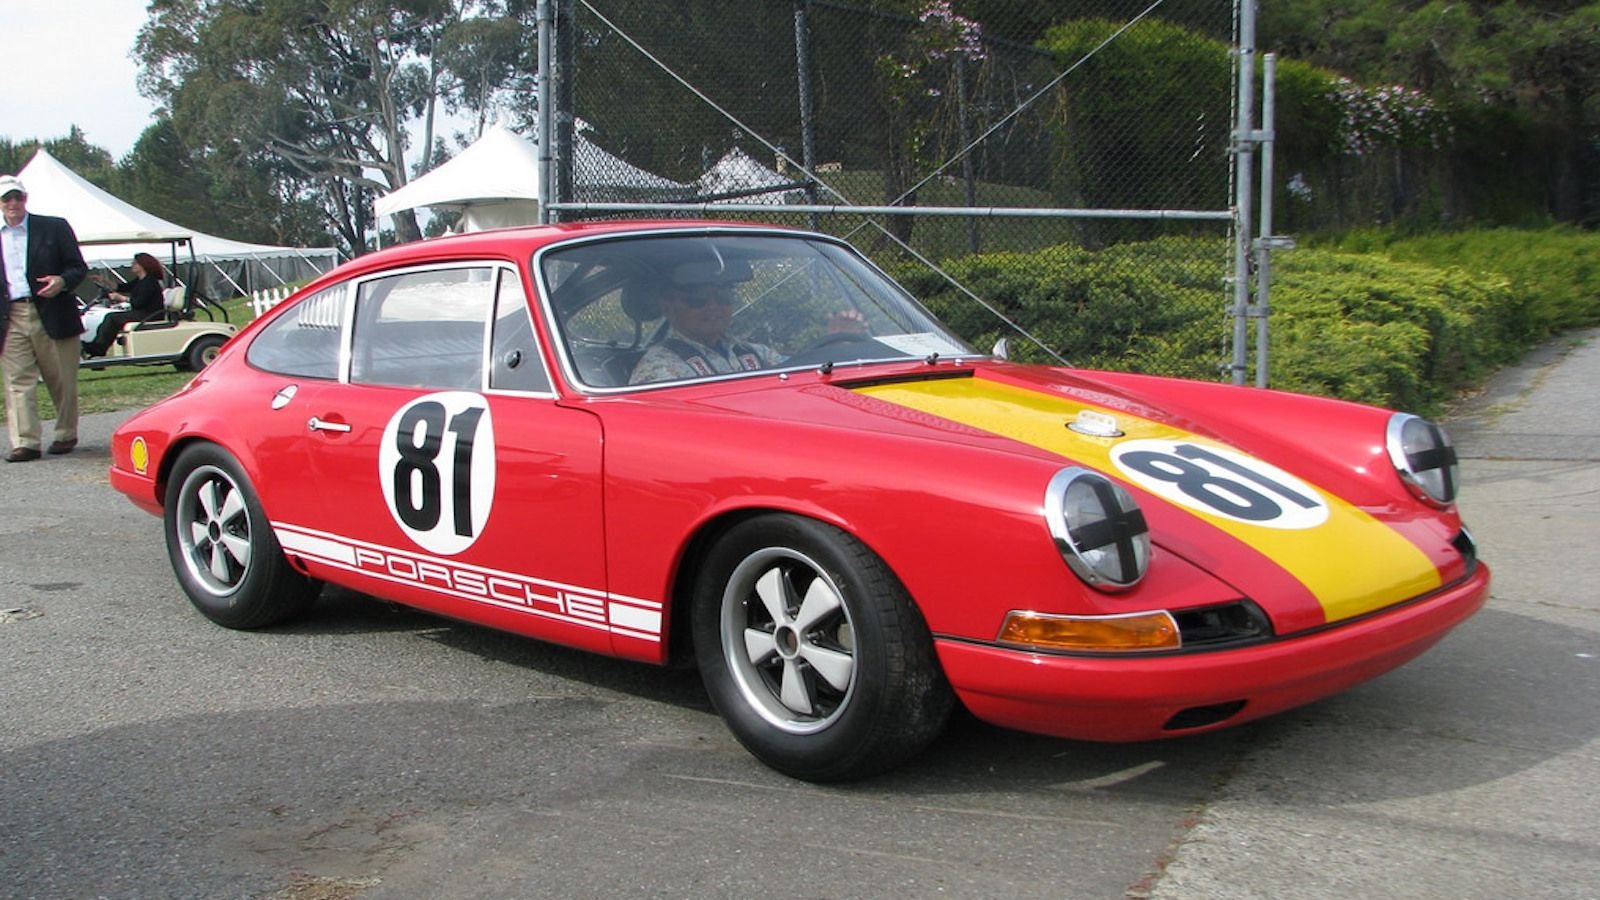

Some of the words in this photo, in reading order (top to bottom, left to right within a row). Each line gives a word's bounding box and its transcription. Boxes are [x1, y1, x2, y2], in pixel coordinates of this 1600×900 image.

[394, 401, 486, 537] 81
[1119, 444, 1322, 521] 81
[356, 547, 606, 622] PORSCHE
